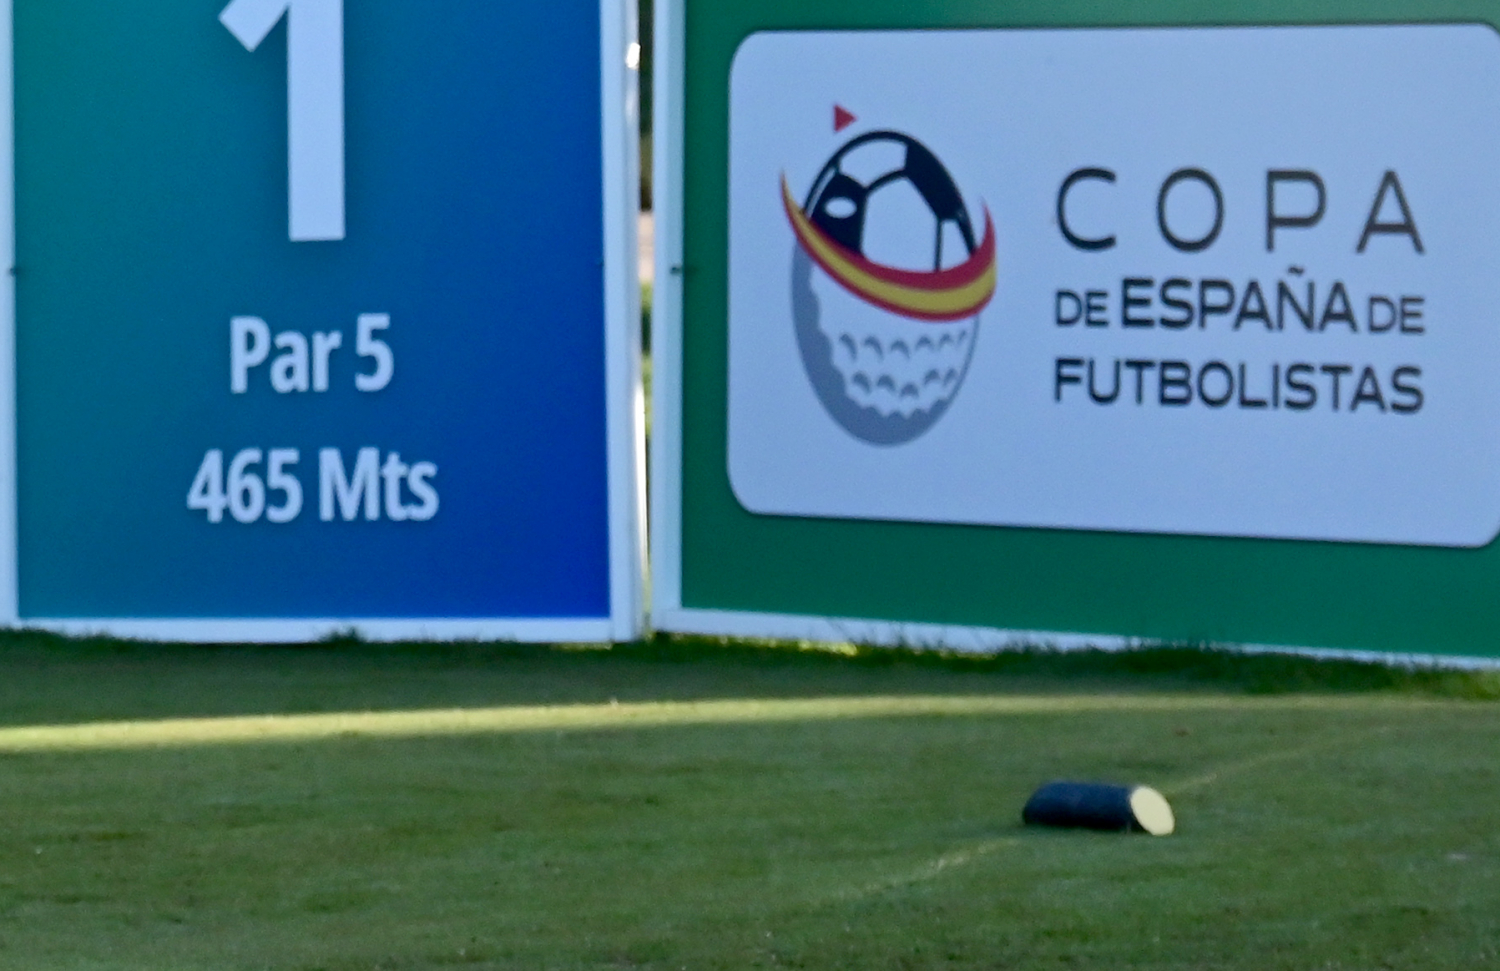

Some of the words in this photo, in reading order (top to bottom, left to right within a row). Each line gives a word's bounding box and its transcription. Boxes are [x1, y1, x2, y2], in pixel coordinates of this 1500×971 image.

[1056, 168, 1425, 254] COPA
[1055, 289, 1109, 327] DE
[1121, 266, 1358, 333] ESPAÑA
[1367, 297, 1426, 333] DE
[230, 316, 342, 393] Par
[355, 313, 394, 392] 5
[1054, 358, 1426, 415] FUTBOLISTAS
[187, 448, 303, 523] 465
[319, 446, 440, 521] Mts
